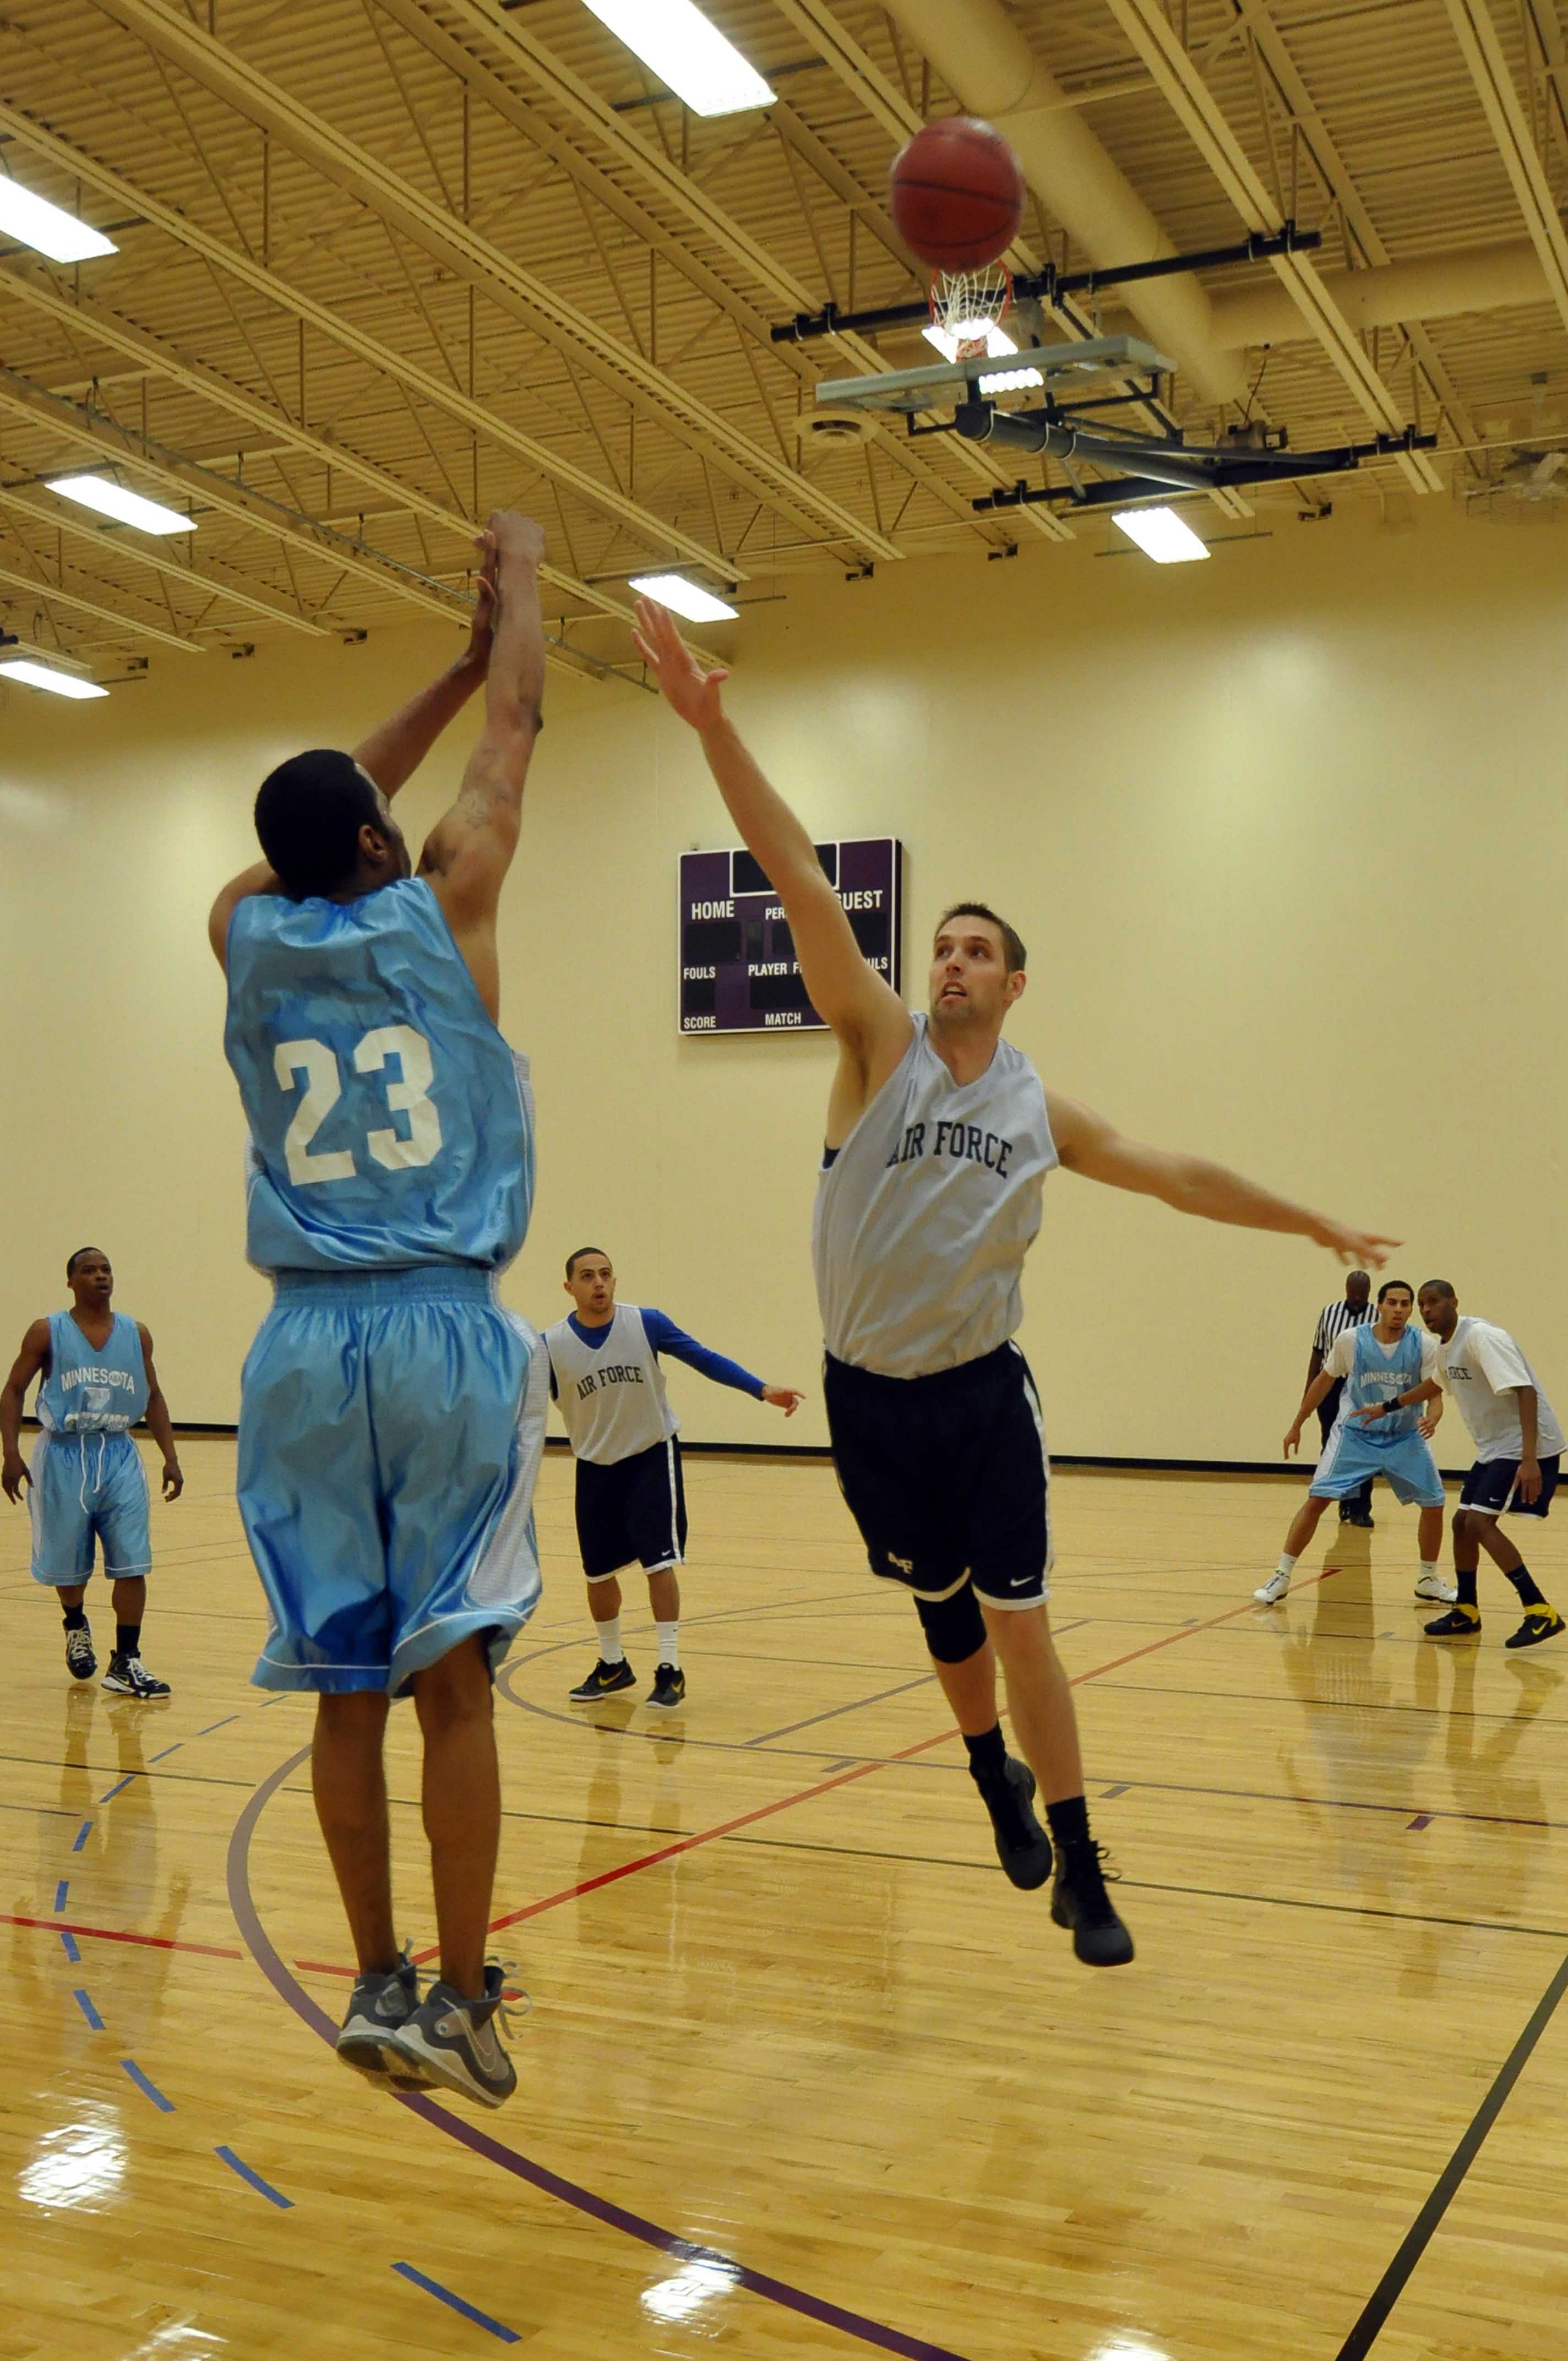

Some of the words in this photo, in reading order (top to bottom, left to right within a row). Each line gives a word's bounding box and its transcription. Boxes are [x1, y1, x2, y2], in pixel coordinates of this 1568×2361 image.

[692, 900, 735, 920] HOME
[765, 907, 787, 920] PER
[748, 962, 787, 976] PLAYER
[867, 957, 888, 970] ULS
[683, 966, 716, 980] FOULS
[684, 1016, 716, 1029] SCORE
[765, 1013, 802, 1025] MATCH
[274, 1025, 443, 1187] 23
[933, 1120, 1012, 1179] FORCE
[61, 1367, 135, 1395] MINNESOTA
[576, 1375, 597, 1400] AIR
[597, 1365, 644, 1387] FORCE
